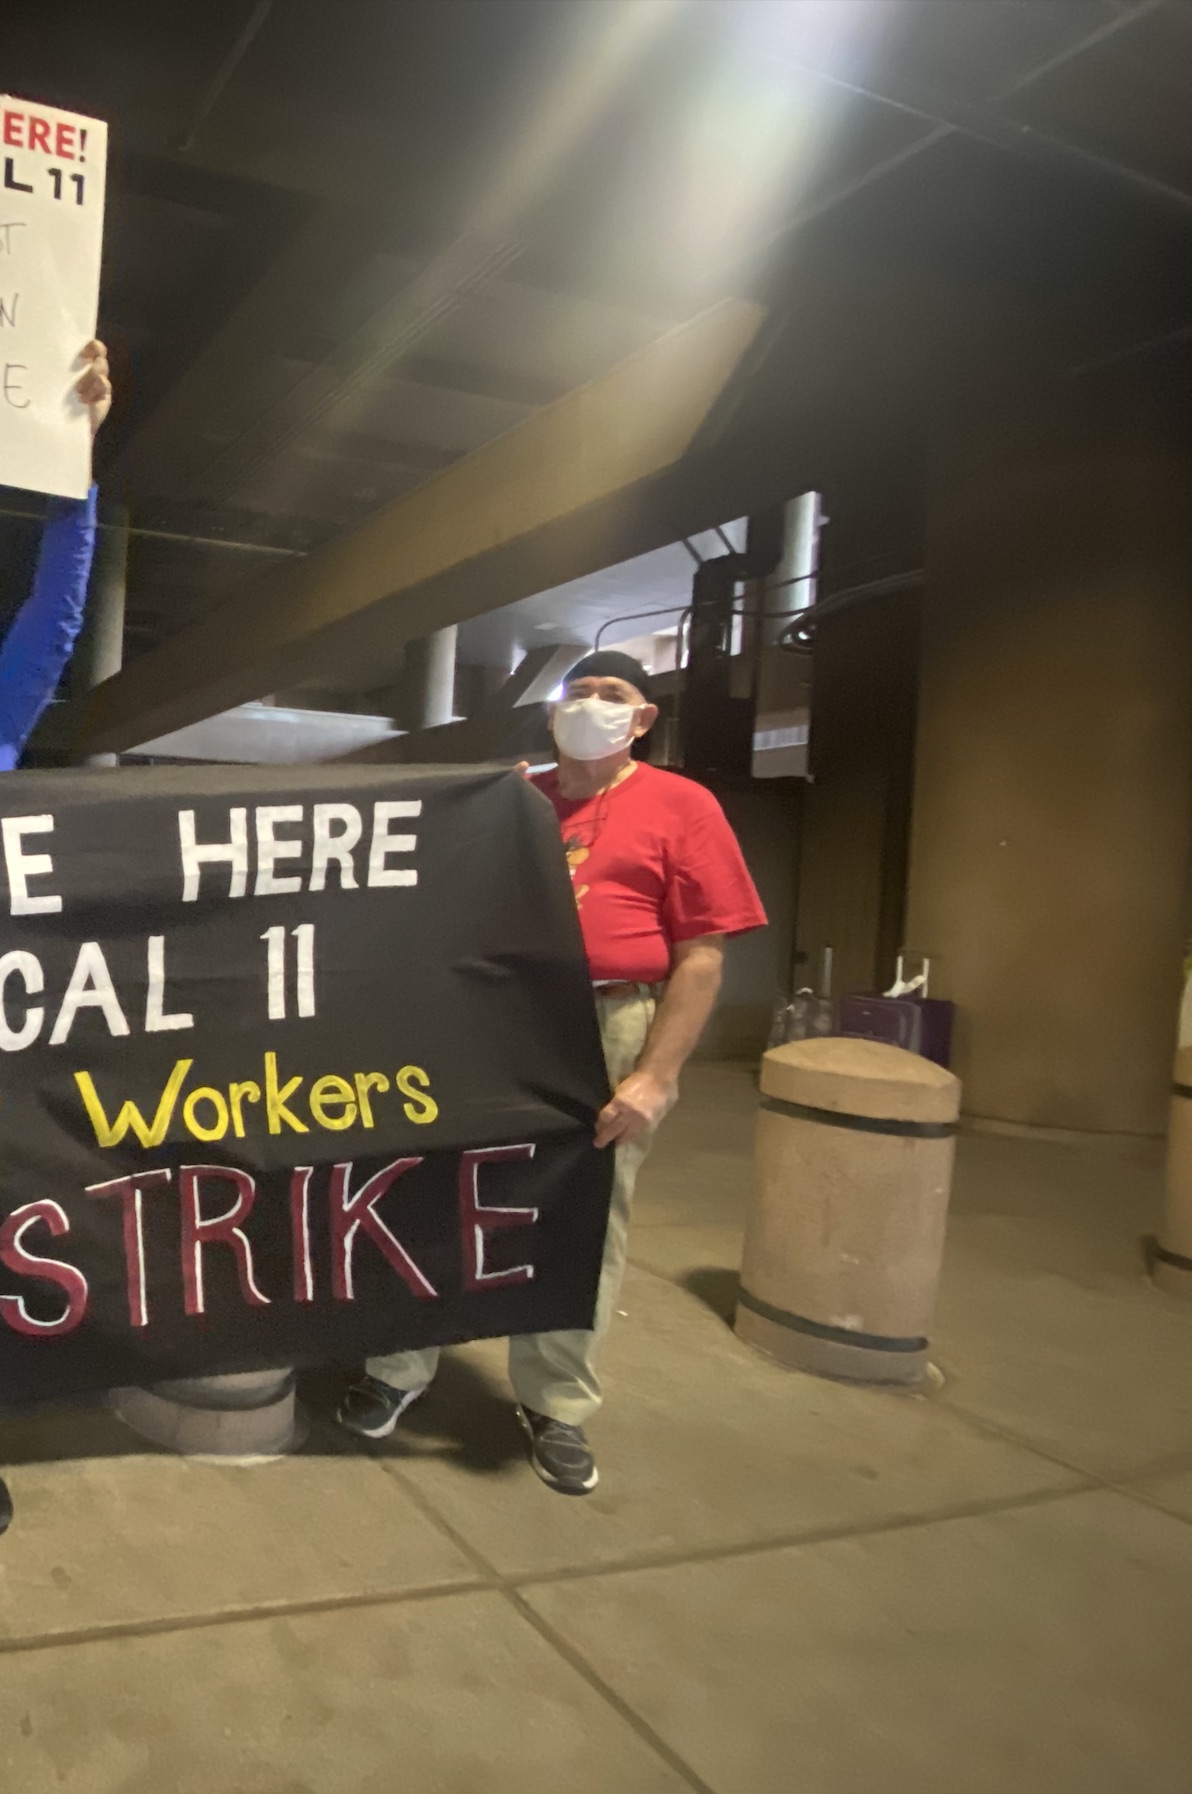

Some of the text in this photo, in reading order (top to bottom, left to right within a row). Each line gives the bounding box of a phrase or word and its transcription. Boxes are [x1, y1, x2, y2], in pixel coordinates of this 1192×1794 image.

[47, 168, 85, 206] 11
[178, 800, 422, 901] HERE
[259, 923, 316, 1020] 11
[74, 1052, 439, 1149] Workers
